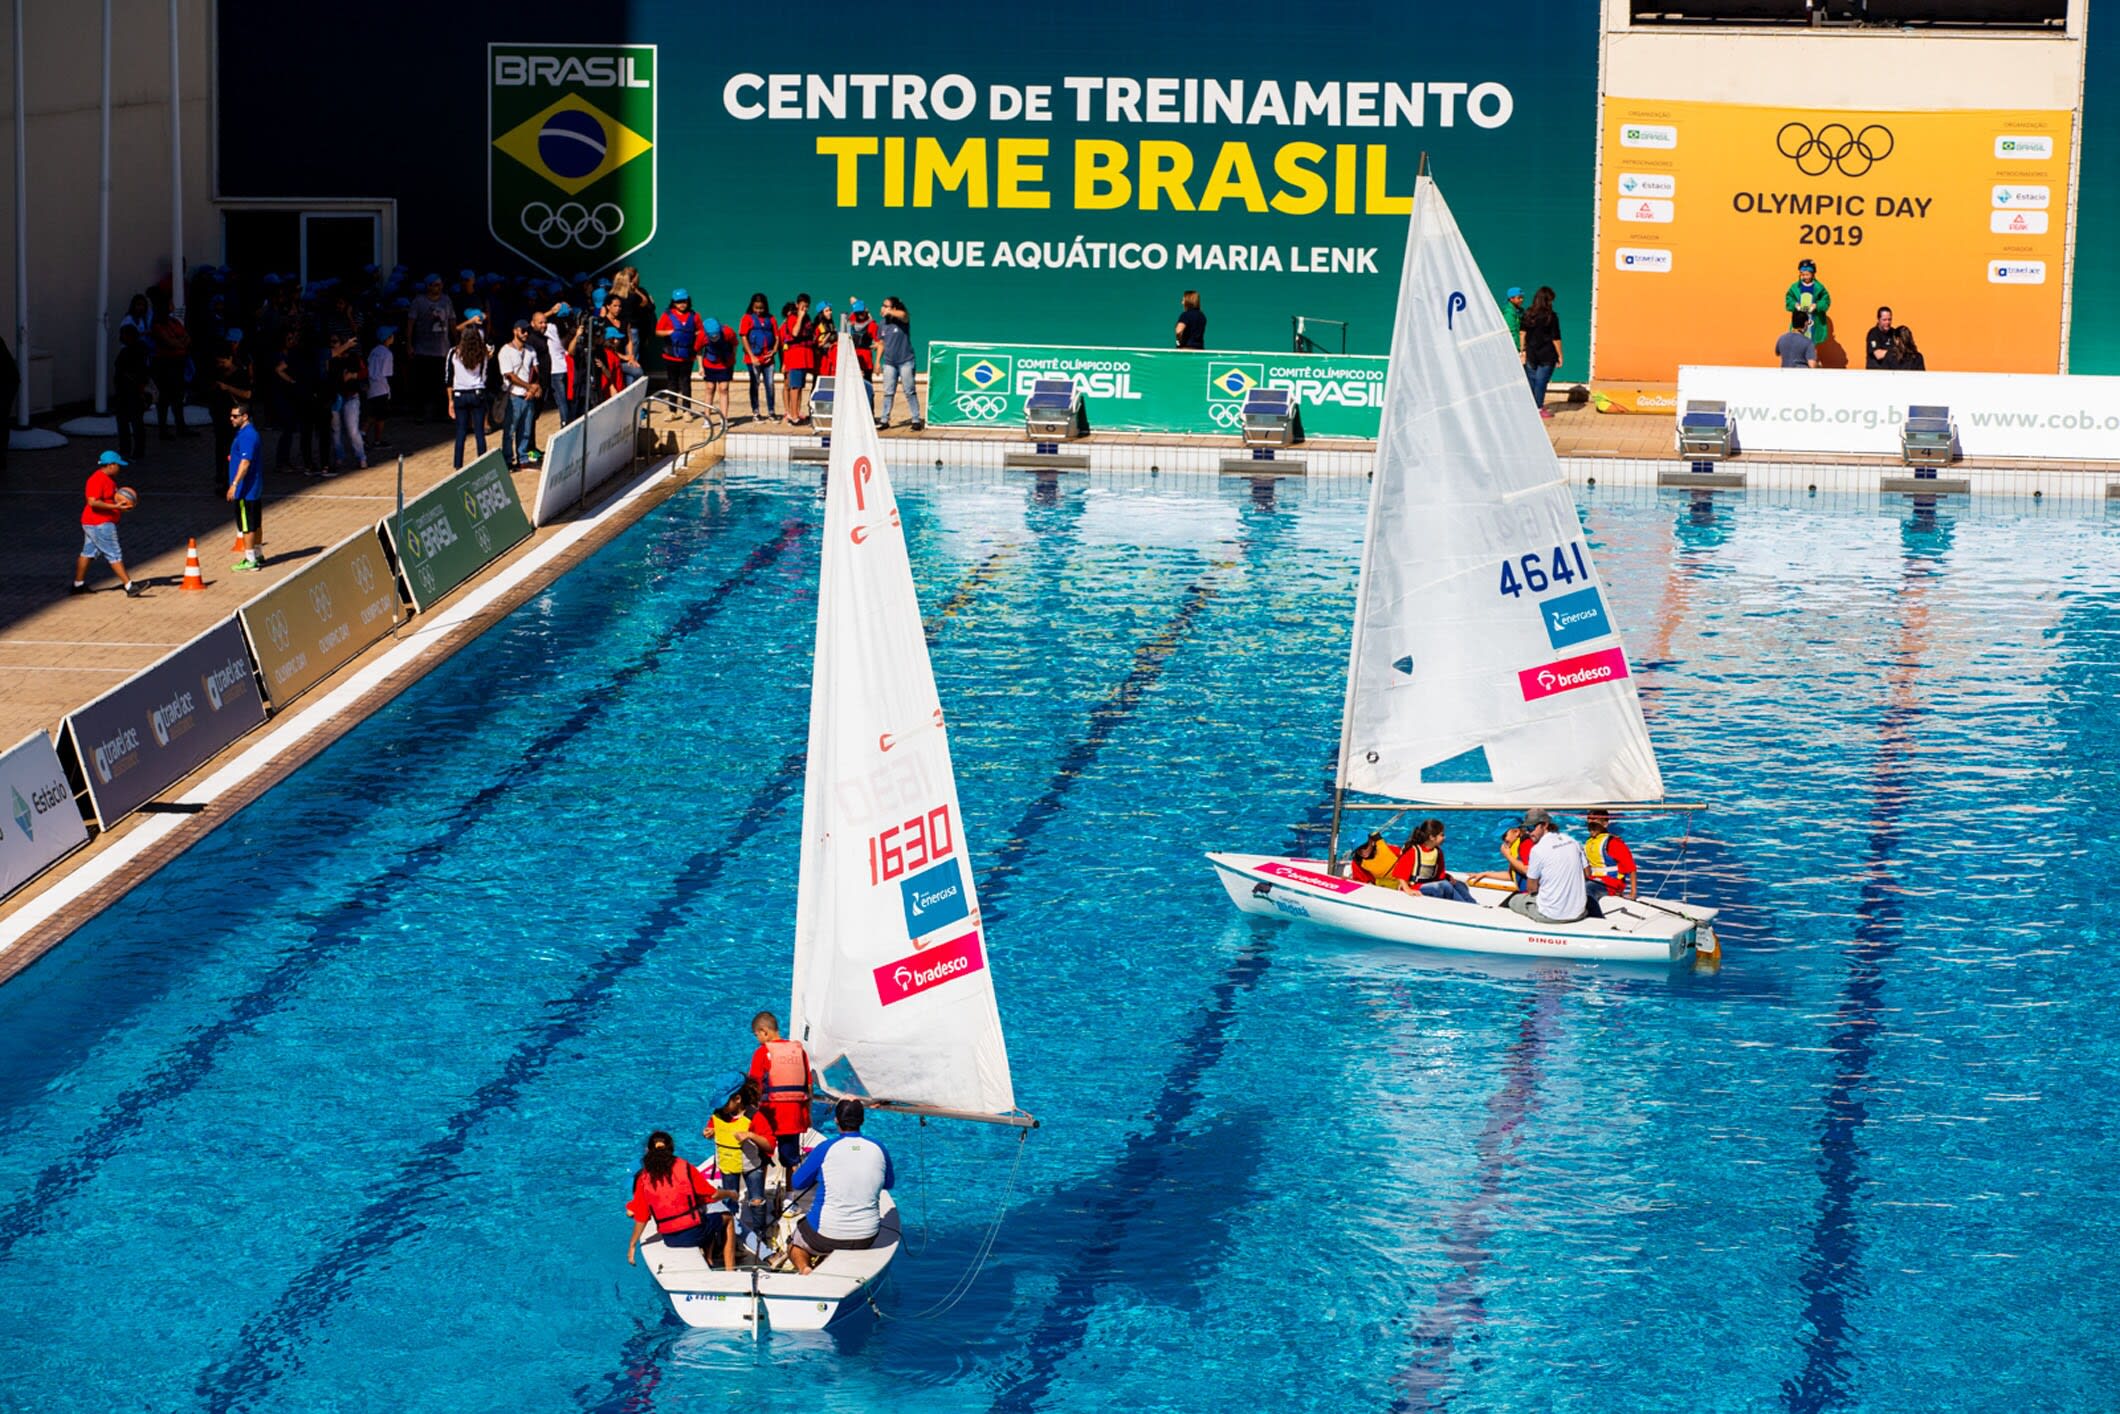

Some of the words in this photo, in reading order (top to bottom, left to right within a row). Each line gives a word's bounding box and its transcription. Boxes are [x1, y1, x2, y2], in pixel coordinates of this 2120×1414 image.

[495, 56, 650, 88] BRASIL
[723, 72, 977, 120] CENTRO
[990, 85, 1052, 121] DE
[1064, 77, 1514, 129] TREINAMENTO
[816, 136, 1051, 208] TIME
[1074, 139, 1414, 216] BRASIL
[1733, 192, 1865, 216] OLYMPIC
[1875, 197, 1933, 218] DAY
[1799, 224, 1863, 246] 2019
[851, 239, 985, 269] PARQUE
[992, 235, 1168, 271] AQUÁTICO
[1176, 244, 1283, 271] MARIA
[1291, 247, 1379, 274] LENK
[1017, 358, 1058, 371] COMITÊ
[1060, 358, 1112, 371] OLÍMPICO
[1113, 361, 1131, 372] DO
[1269, 366, 1312, 378] COMITÊ
[1313, 367, 1365, 380] OLÍMPICO
[1366, 370, 1384, 380] DO
[1500, 541, 1588, 598] 4641
[1559, 664, 1611, 687] bradesco
[32, 780, 67, 814] Estácio
[869, 803, 953, 886] 1630
[920, 885, 957, 908] energisa
[1528, 936, 1568, 945] DINGUE
[913, 955, 968, 987] bradesco
